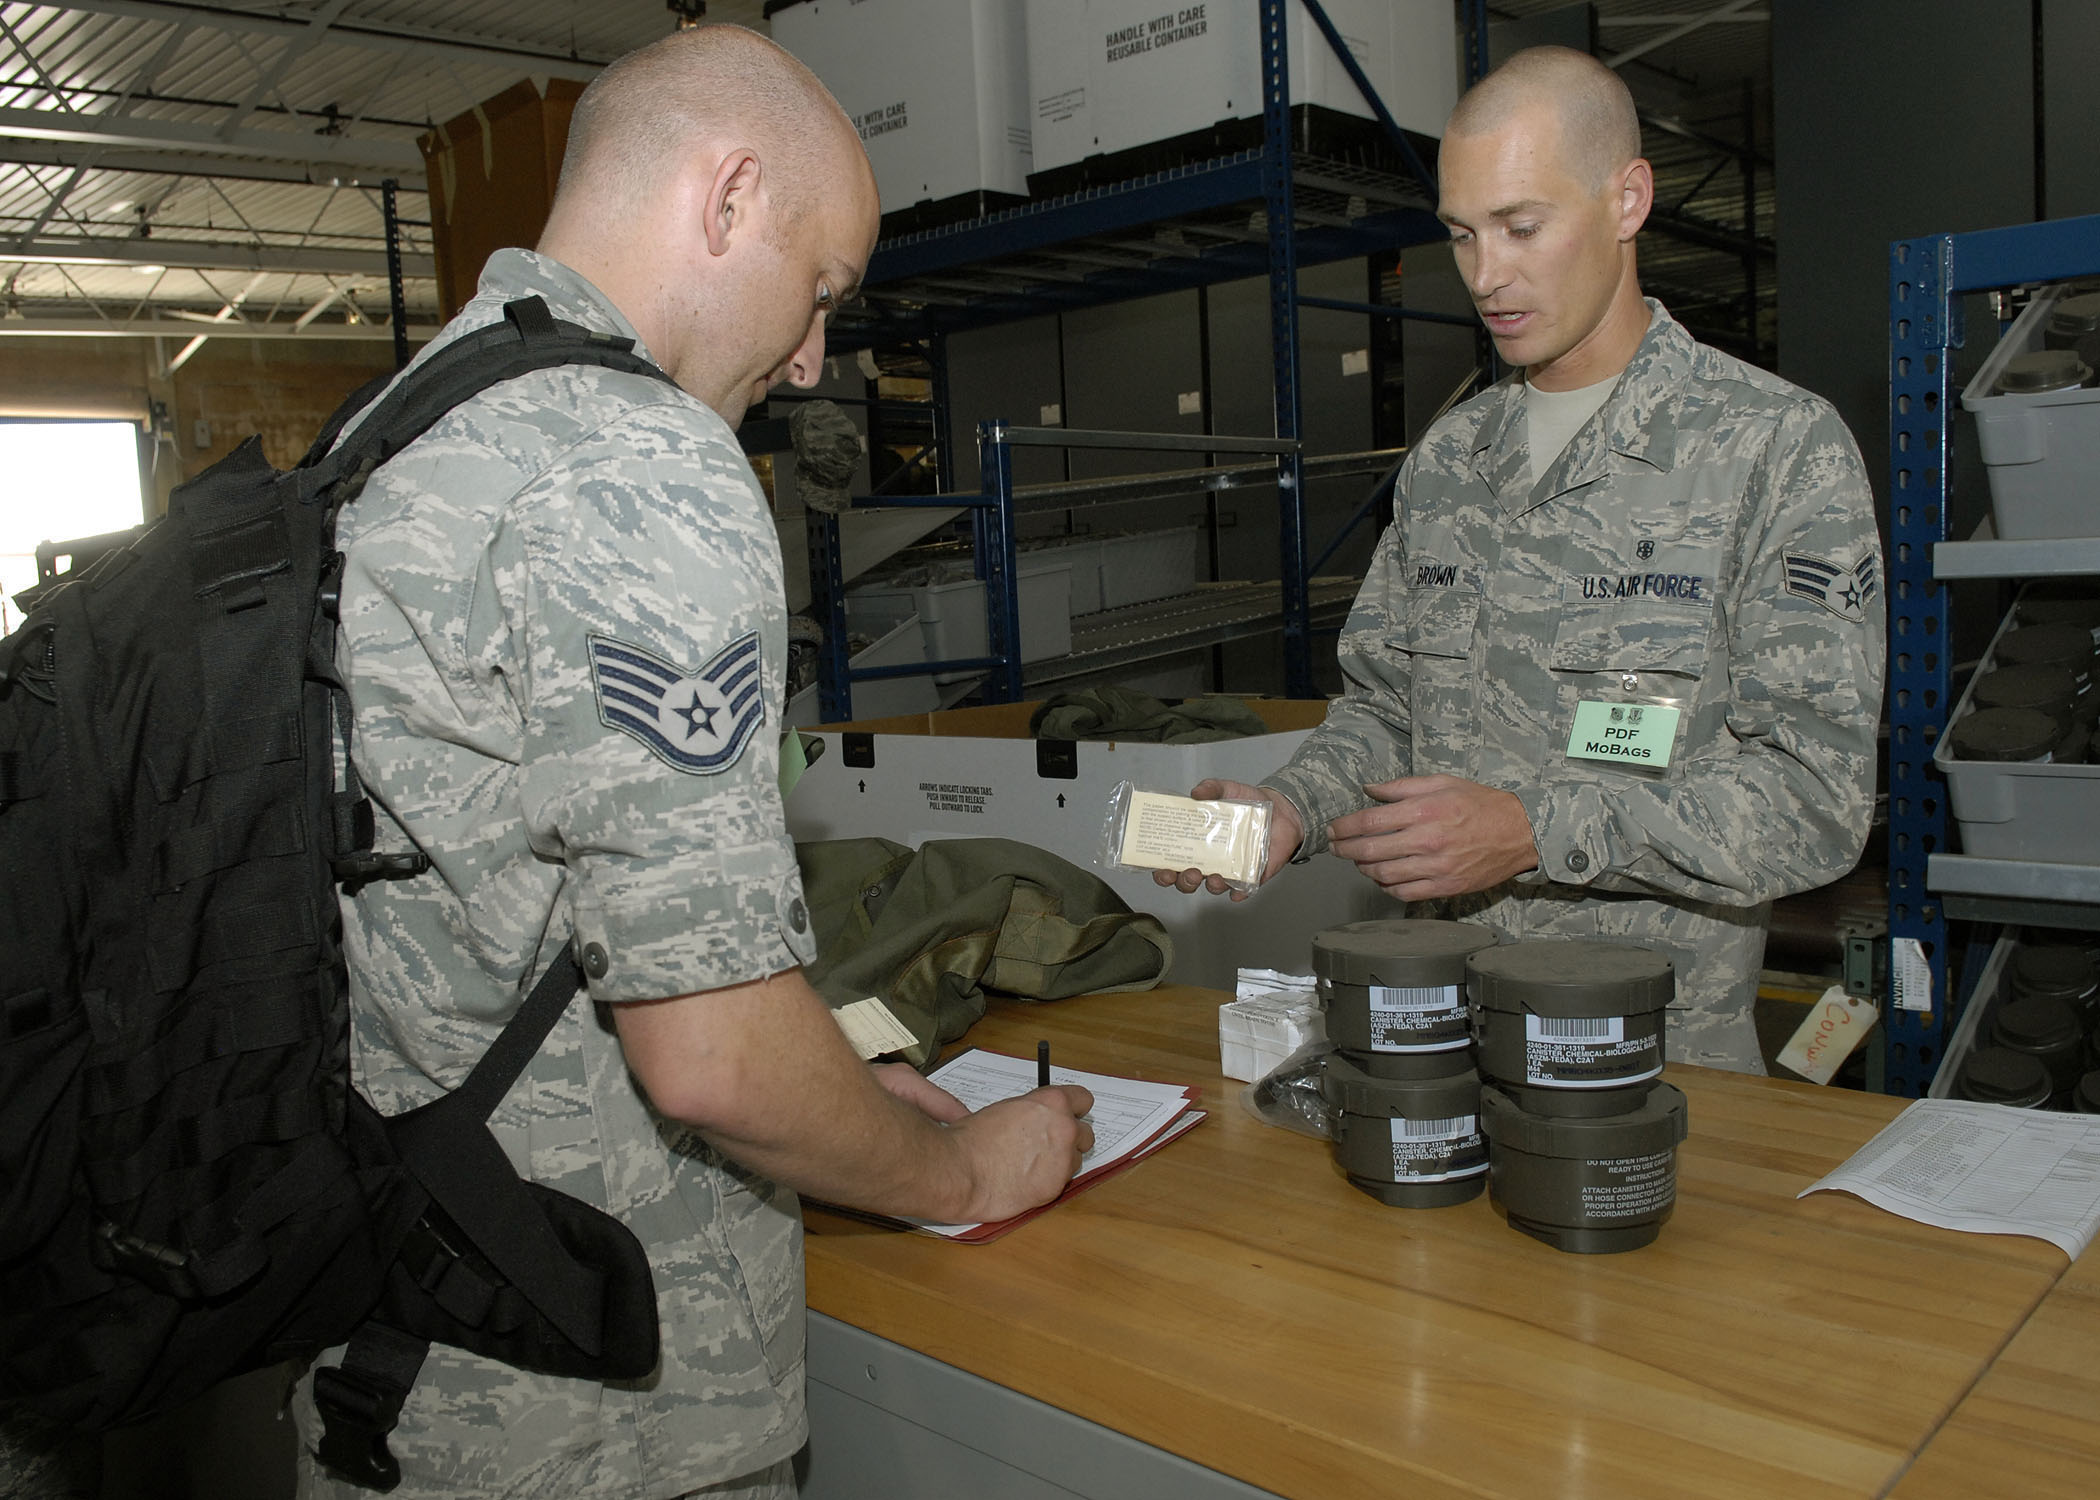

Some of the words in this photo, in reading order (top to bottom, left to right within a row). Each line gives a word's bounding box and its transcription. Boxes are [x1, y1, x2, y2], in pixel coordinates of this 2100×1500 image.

[1106, 23, 1144, 47] HANDLE
[1148, 14, 1174, 34] WITH
[1178, 4, 1205, 24] CARE
[1107, 37, 1152, 62] REUSABLE
[1154, 20, 1207, 48] CONTAINER
[864, 110, 883, 124] WITH
[886, 101, 906, 118] CARE
[870, 116, 907, 138] CONTAINER
[1416, 565, 1457, 586] BROWN
[1583, 576, 1610, 598] U.S.
[1615, 576, 1640, 598] AIR
[1643, 574, 1702, 599] FORCE
[1605, 728, 1639, 740] PDF
[920, 783, 938, 792] ARROWS
[939, 784, 959, 793] INDICATE
[960, 786, 979, 794] LOCKING
[927, 792, 938, 800] PUSH
[940, 794, 958, 802] INWARD
[959, 795, 964, 803] TO
[930, 802, 940, 810] PULL
[942, 803, 963, 812] OUTWARD
[964, 804, 969, 812] TO
[1527, 1042, 1585, 1051] 4240-01-361-1319
[1527, 1048, 1566, 1058] CANISTER,
[1566, 1044, 1643, 1057] CHEMICAL-BIOLOGICAL
[1609, 1166, 1631, 1174] READY
[1633, 1164, 1640, 1172] TO
[1642, 1160, 1654, 1170] USE
[1612, 1184, 1644, 1193] CANISTER
[1616, 1190, 1655, 1201] CONNECTOR
[1585, 1202, 1615, 1210] PROPER
[1616, 1198, 1652, 1209] OPERATION
[1586, 1208, 1635, 1217] ACCORDANCE
[1636, 1206, 1650, 1214] WITH
